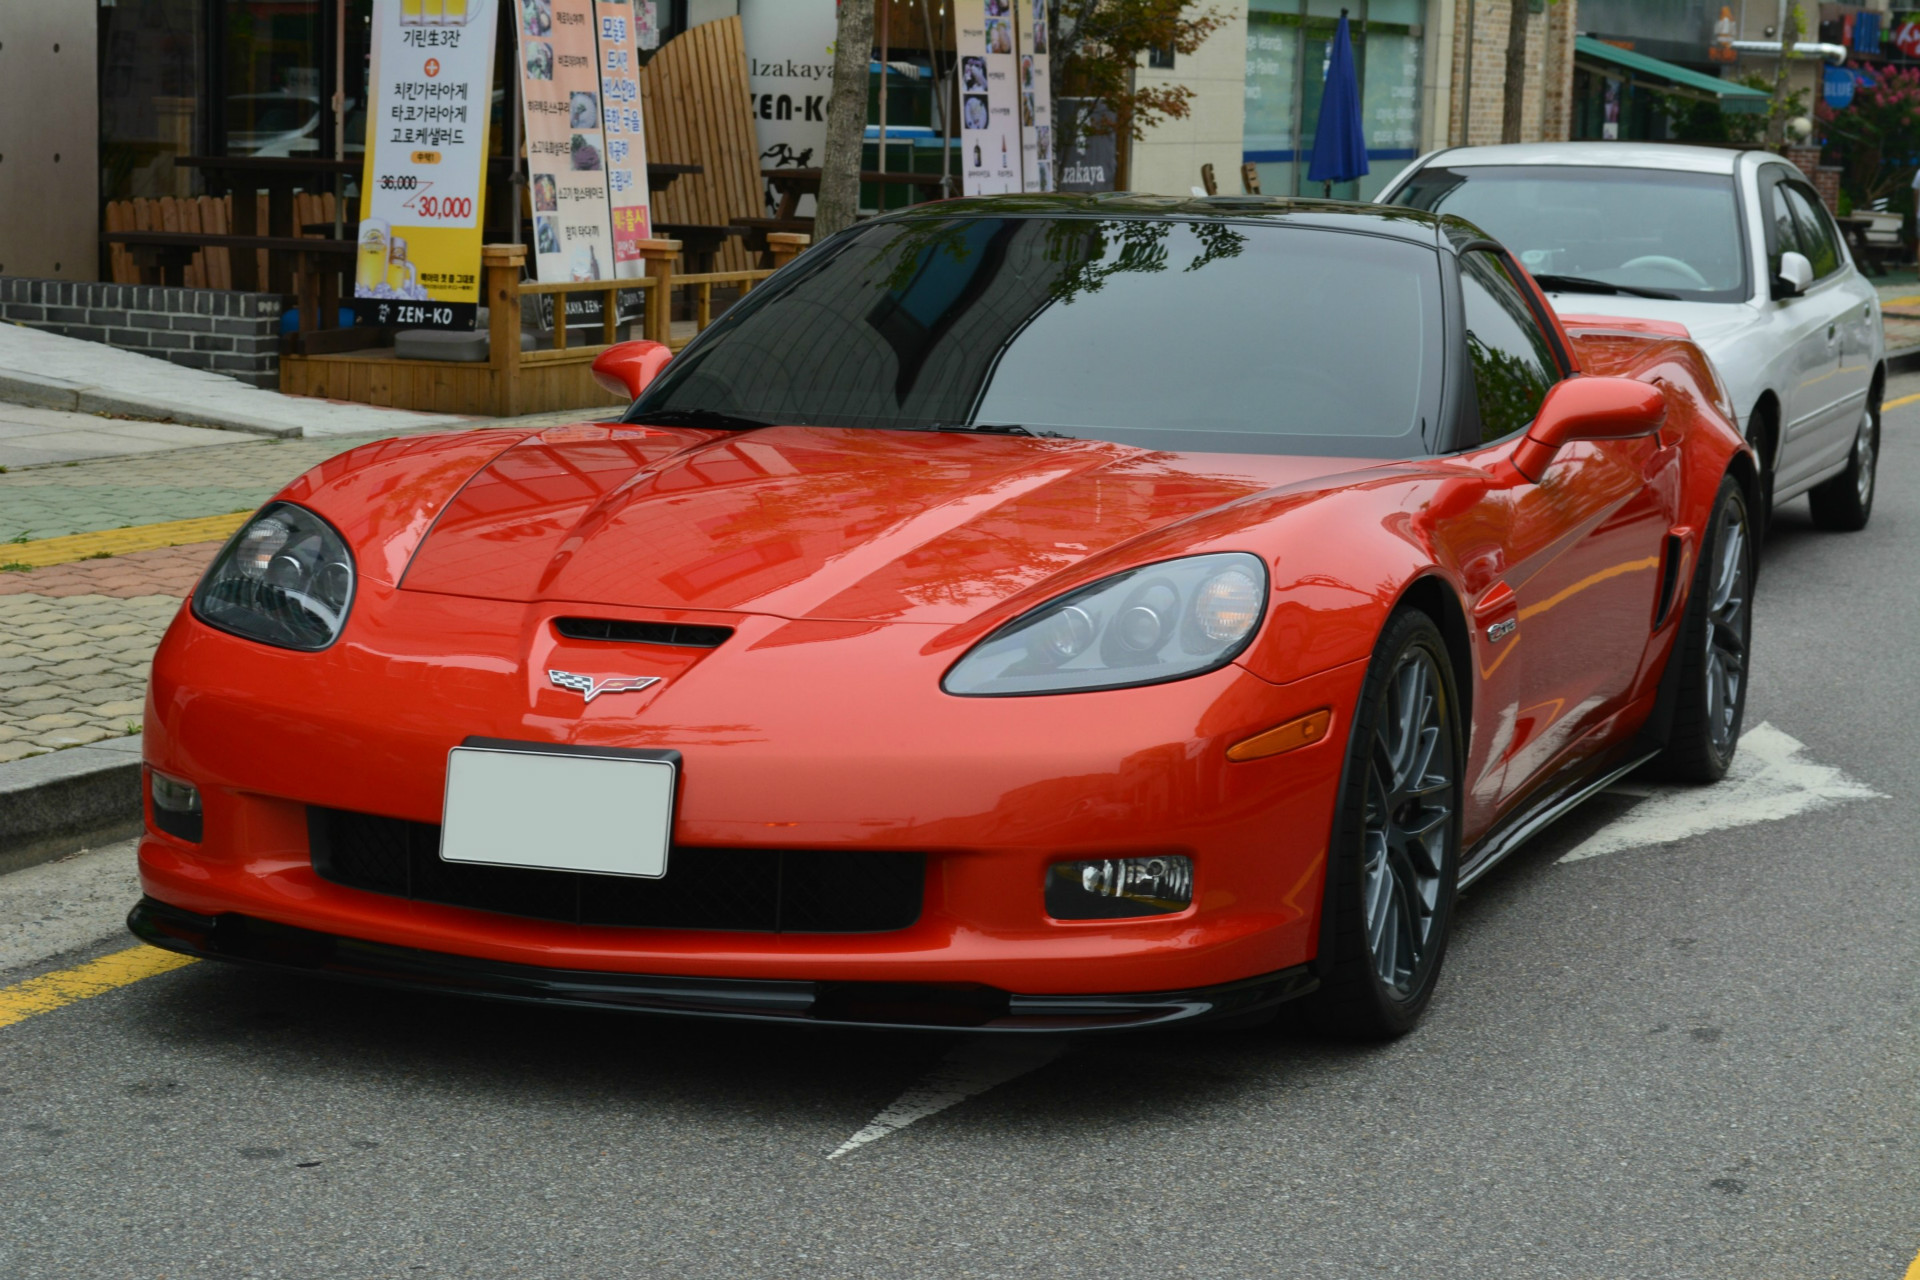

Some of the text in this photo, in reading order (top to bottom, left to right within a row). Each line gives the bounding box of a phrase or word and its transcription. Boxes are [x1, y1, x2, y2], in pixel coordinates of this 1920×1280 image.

[403, 29, 461, 49] 기린生3잔
[393, 82, 469, 101] 치킨가라아게
[1824, 82, 1852, 97] BLUE
[391, 104, 467, 123] 타코가라아게
[751, 93, 830, 122] EN-K
[390, 128, 465, 146] 고로케샐러드
[380, 175, 417, 191] 36,000
[1062, 161, 1105, 186] zakaya
[418, 196, 472, 219] 30,000
[397, 306, 453, 324] ZEN-KO
